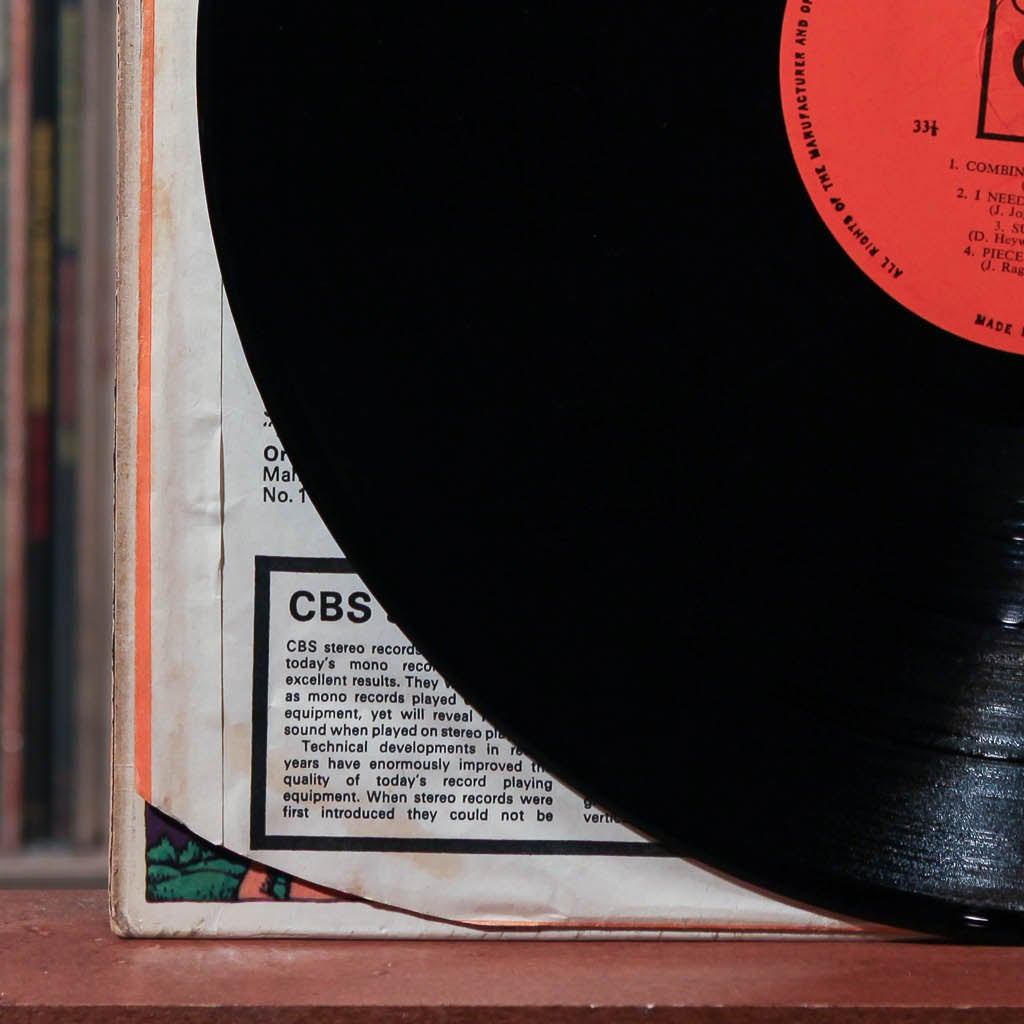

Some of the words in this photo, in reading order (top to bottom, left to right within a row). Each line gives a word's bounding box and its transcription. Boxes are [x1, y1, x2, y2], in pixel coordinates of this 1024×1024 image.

[795, 19, 809, 46] AND
[794, 52, 821, 160] MANUFACTURER
[843, 215, 880, 257] RIGHTS
[983, 247, 1024, 262] PIECE
[974, 313, 1013, 336] MADE
[263, 487, 293, 503] No.
[289, 590, 372, 624] CBS
[286, 640, 317, 653] CBS
[324, 643, 365, 654] stereo
[285, 657, 335, 671] today's
[350, 661, 388, 671] mono
[285, 674, 347, 685] excellent
[352, 675, 400, 687] results.
[405, 676, 439, 690] They
[285, 692, 300, 702] as
[308, 692, 347, 703] mono
[355, 692, 404, 703] records
[412, 693, 457, 706] played
[285, 707, 362, 721] equipment,
[371, 709, 392, 721] yet
[401, 708, 424, 720] will
[433, 710, 473, 722] reveal
[284, 724, 326, 736] sound
[331, 724, 368, 736] when
[372, 725, 417, 738] played
[421, 727, 437, 737] on
[441, 727, 482, 739] stereo
[302, 740, 368, 753] Technical
[379, 741, 476, 755] developments
[284, 759, 319, 771] years
[328, 757, 361, 769] have
[370, 758, 450, 772] enormously
[459, 758, 522, 773] improved
[283, 773, 330, 787] quality
[346, 774, 360, 786] of
[377, 774, 427, 788] today's
[443, 775, 486, 787] record
[503, 777, 553, 791] playing
[283, 789, 360, 804] equipment.
[367, 791, 407, 803] When
[414, 793, 456, 804] stereo
[462, 792, 513, 804] records
[520, 796, 553, 805] were
[283, 806, 309, 818] first
[321, 807, 395, 819] introduced
[408, 808, 438, 822] they
[450, 809, 488, 821] could
[501, 810, 524, 821] not
[537, 810, 553, 821] be
